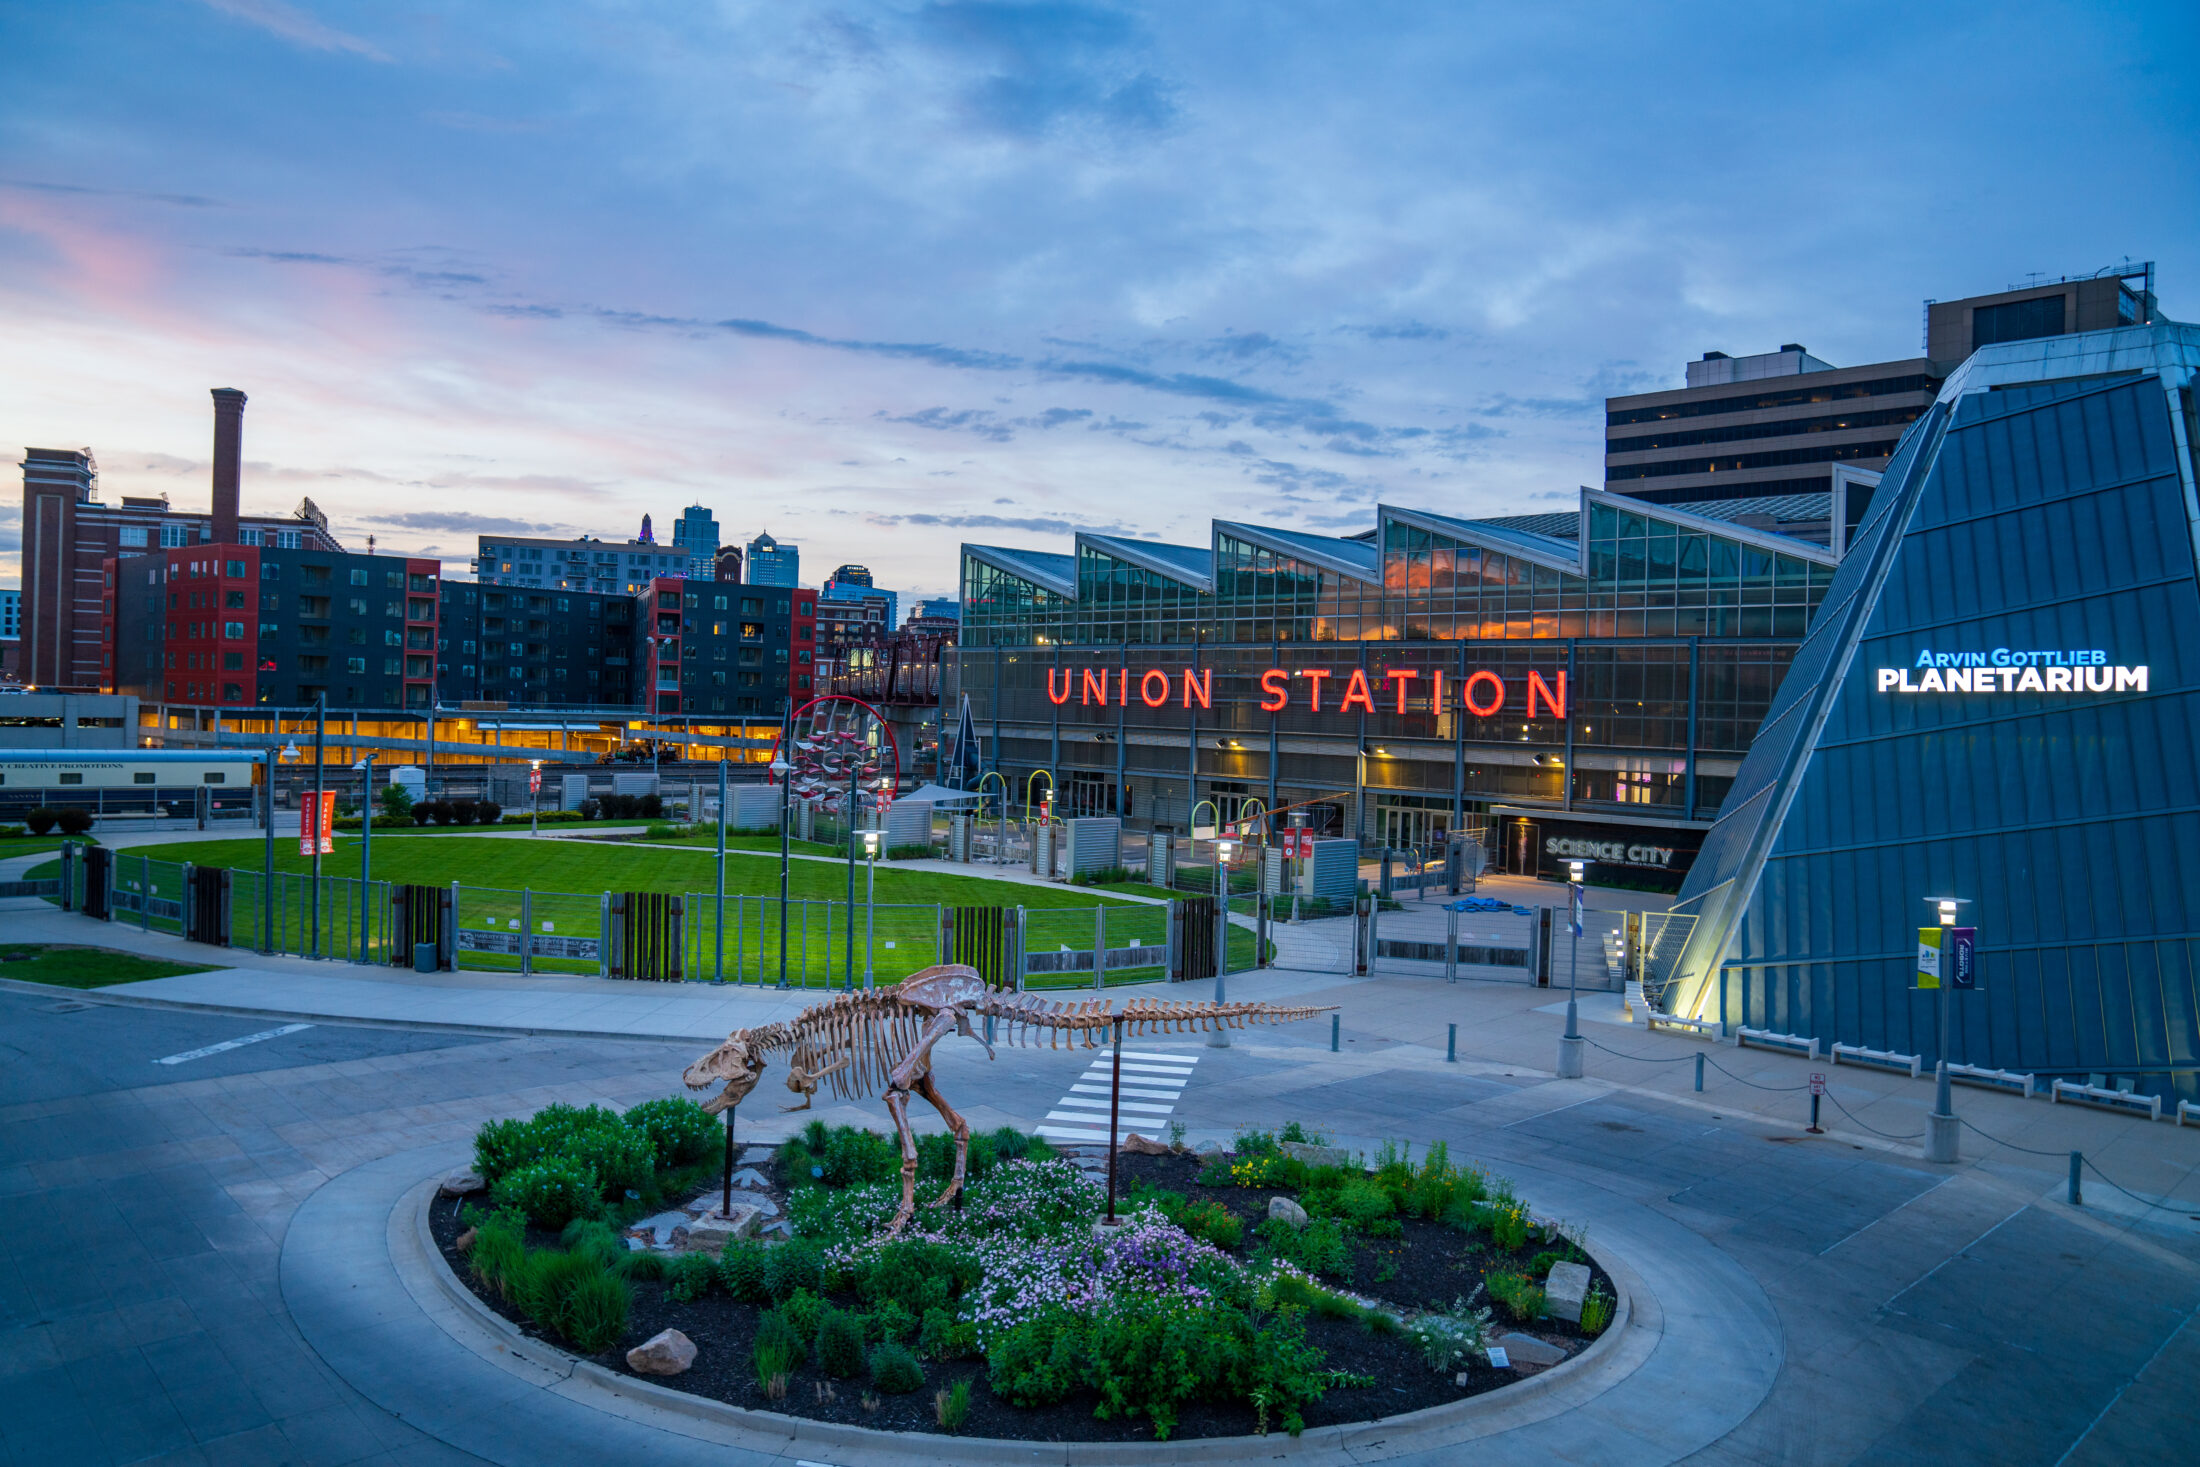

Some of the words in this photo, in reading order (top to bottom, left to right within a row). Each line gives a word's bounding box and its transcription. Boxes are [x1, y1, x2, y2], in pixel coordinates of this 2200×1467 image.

[1877, 665, 2149, 693] PLANETARIUM
[1047, 668, 1214, 709] UNION
[1260, 668, 1569, 719] STATION
[1546, 838, 1625, 859] SCIENCE
[1628, 846, 1673, 864] CITY
